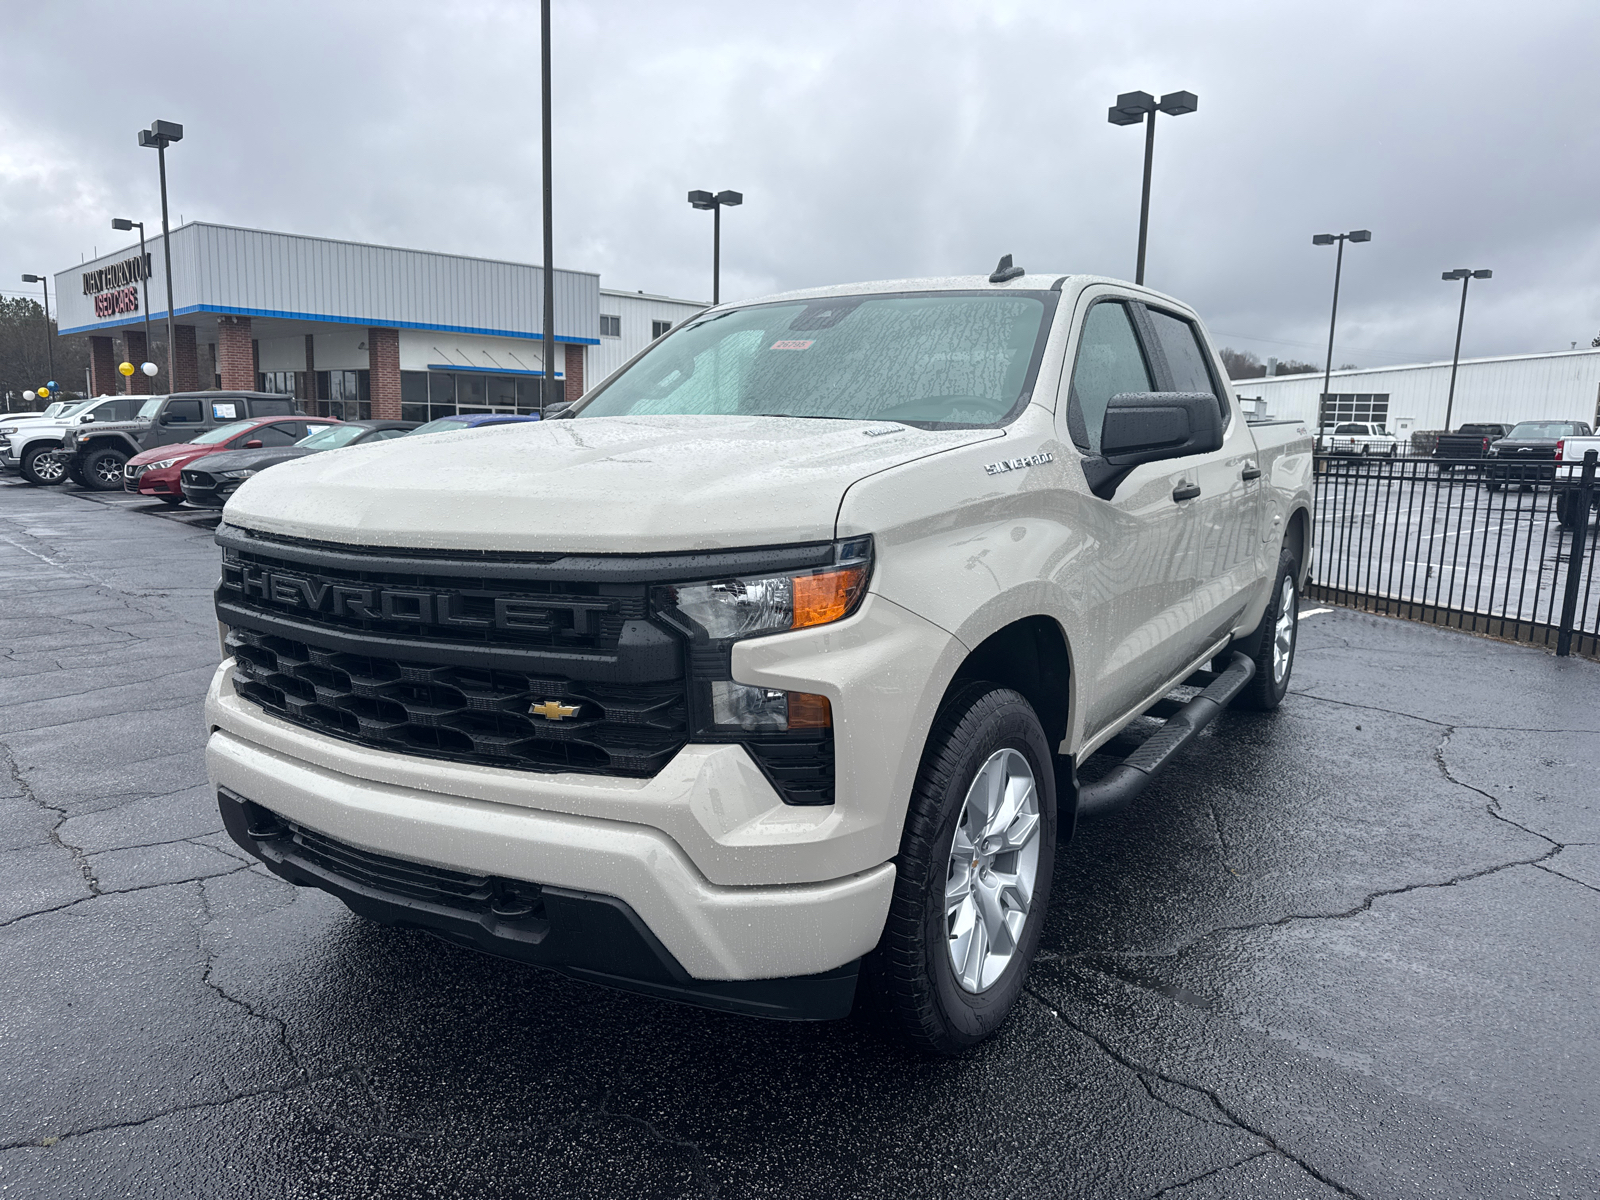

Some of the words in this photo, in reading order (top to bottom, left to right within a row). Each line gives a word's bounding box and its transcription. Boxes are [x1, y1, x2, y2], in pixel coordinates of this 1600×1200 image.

[82, 269, 103, 295] JOHN
[94, 292, 114, 317] USED
[113, 286, 138, 313] CARS
[222, 561, 620, 636] CHEVROLET
